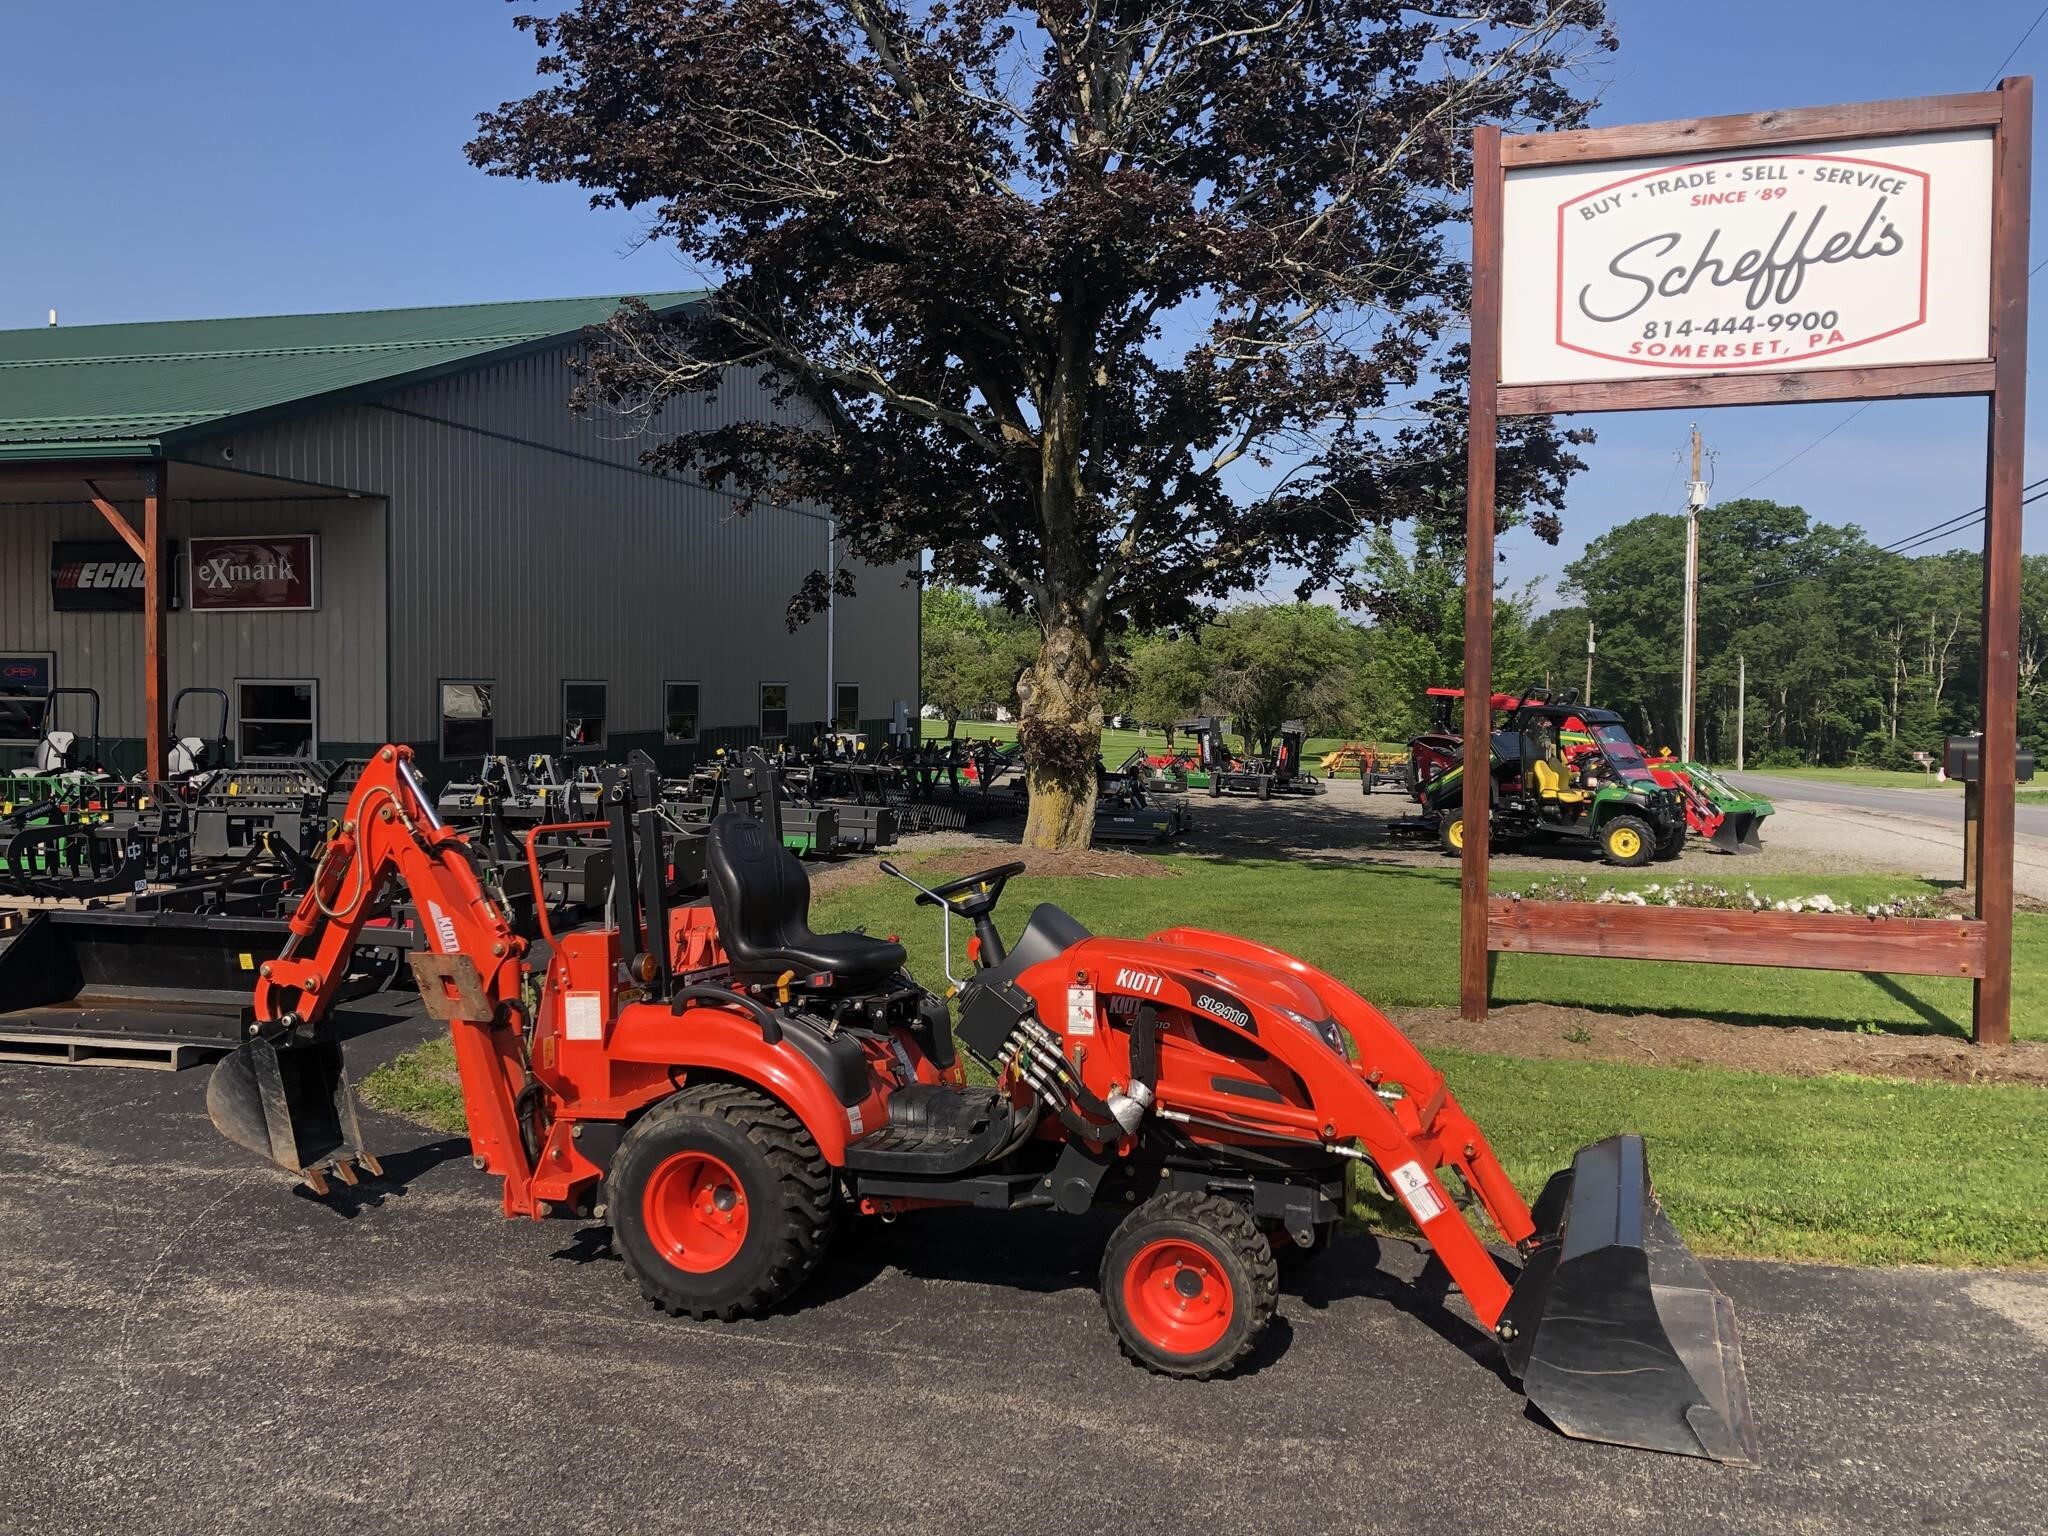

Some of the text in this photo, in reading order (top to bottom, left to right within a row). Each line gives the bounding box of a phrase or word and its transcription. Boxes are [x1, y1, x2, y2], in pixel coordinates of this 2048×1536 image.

[1580, 165, 1907, 221] BUY TRADE SELL SERVICE
[1690, 187, 1787, 206] SINCE '89
[1579, 196, 1904, 322] Scheffel's
[1642, 310, 1839, 340] 814-444-9900
[1628, 329, 1844, 358] SOMERSET, PA
[198, 556, 300, 589] eXmark
[4, 667, 37, 678] OPEN
[438, 916, 461, 953] KIOTI
[1115, 968, 1163, 996] KIOTI
[1196, 995, 1249, 1027] SL2410
